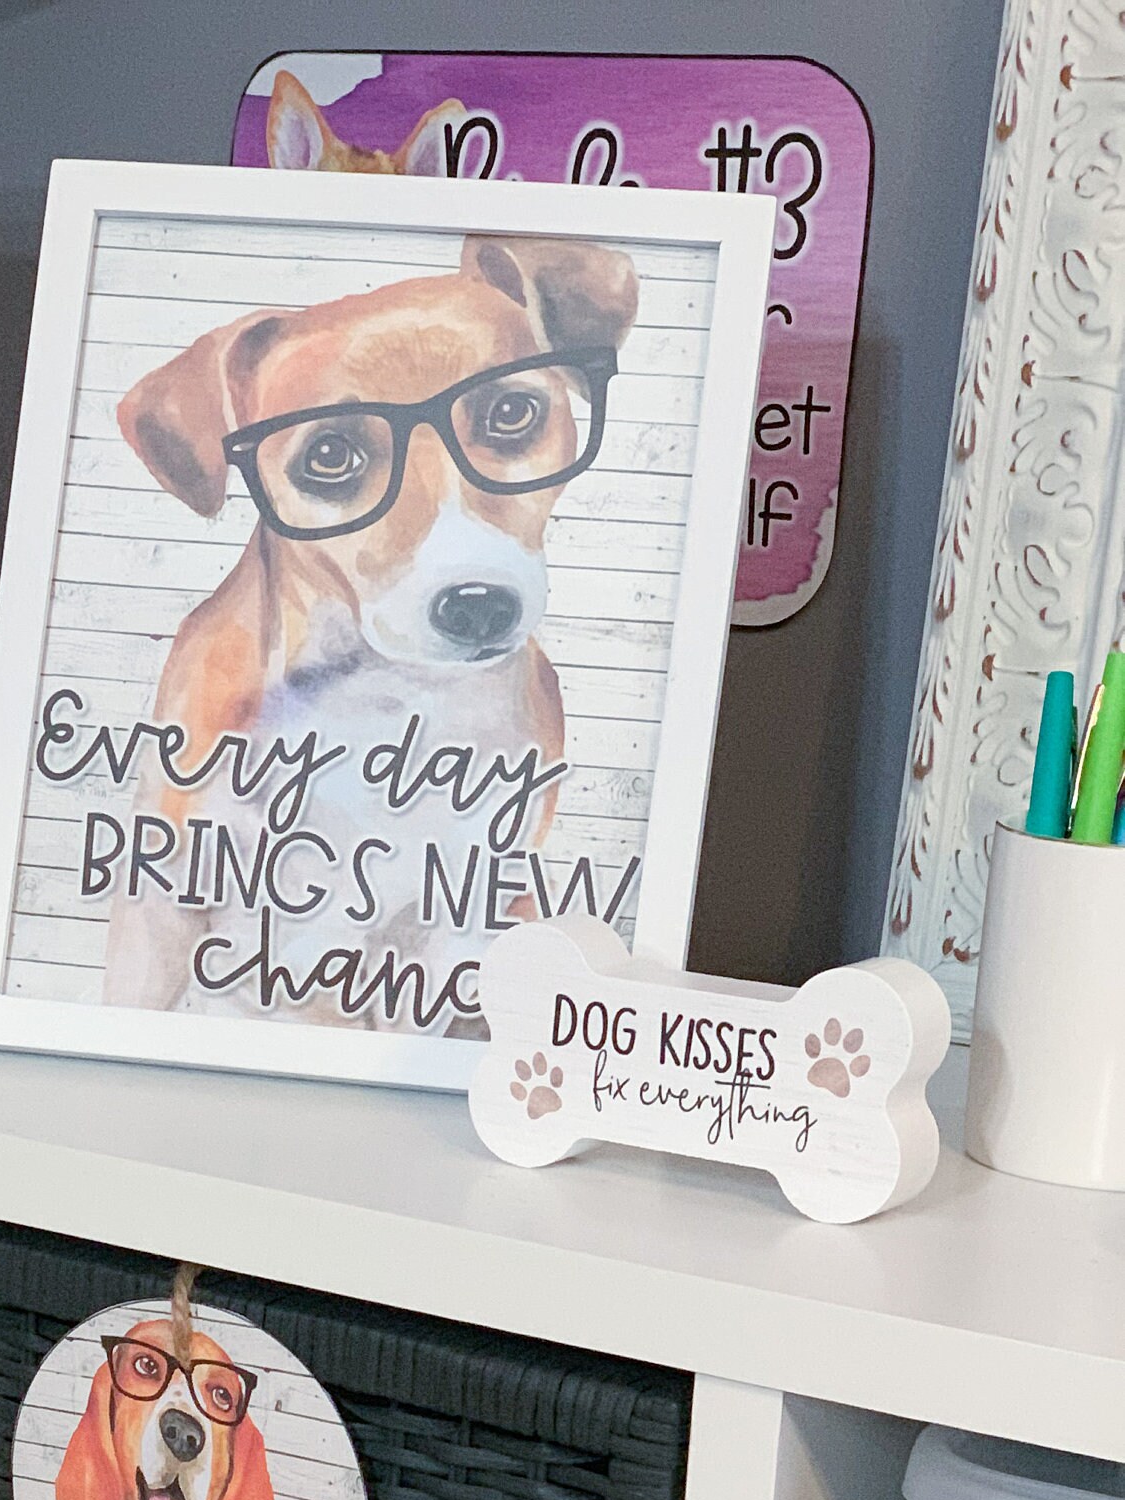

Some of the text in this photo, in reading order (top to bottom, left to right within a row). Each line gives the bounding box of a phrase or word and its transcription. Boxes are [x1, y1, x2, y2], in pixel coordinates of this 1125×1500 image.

[36, 689, 568, 853] Every day
[80, 812, 641, 930] BRINGS NEW
[551, 993, 777, 1081] DOG KISSES
[593, 1049, 818, 1152] fix everything
